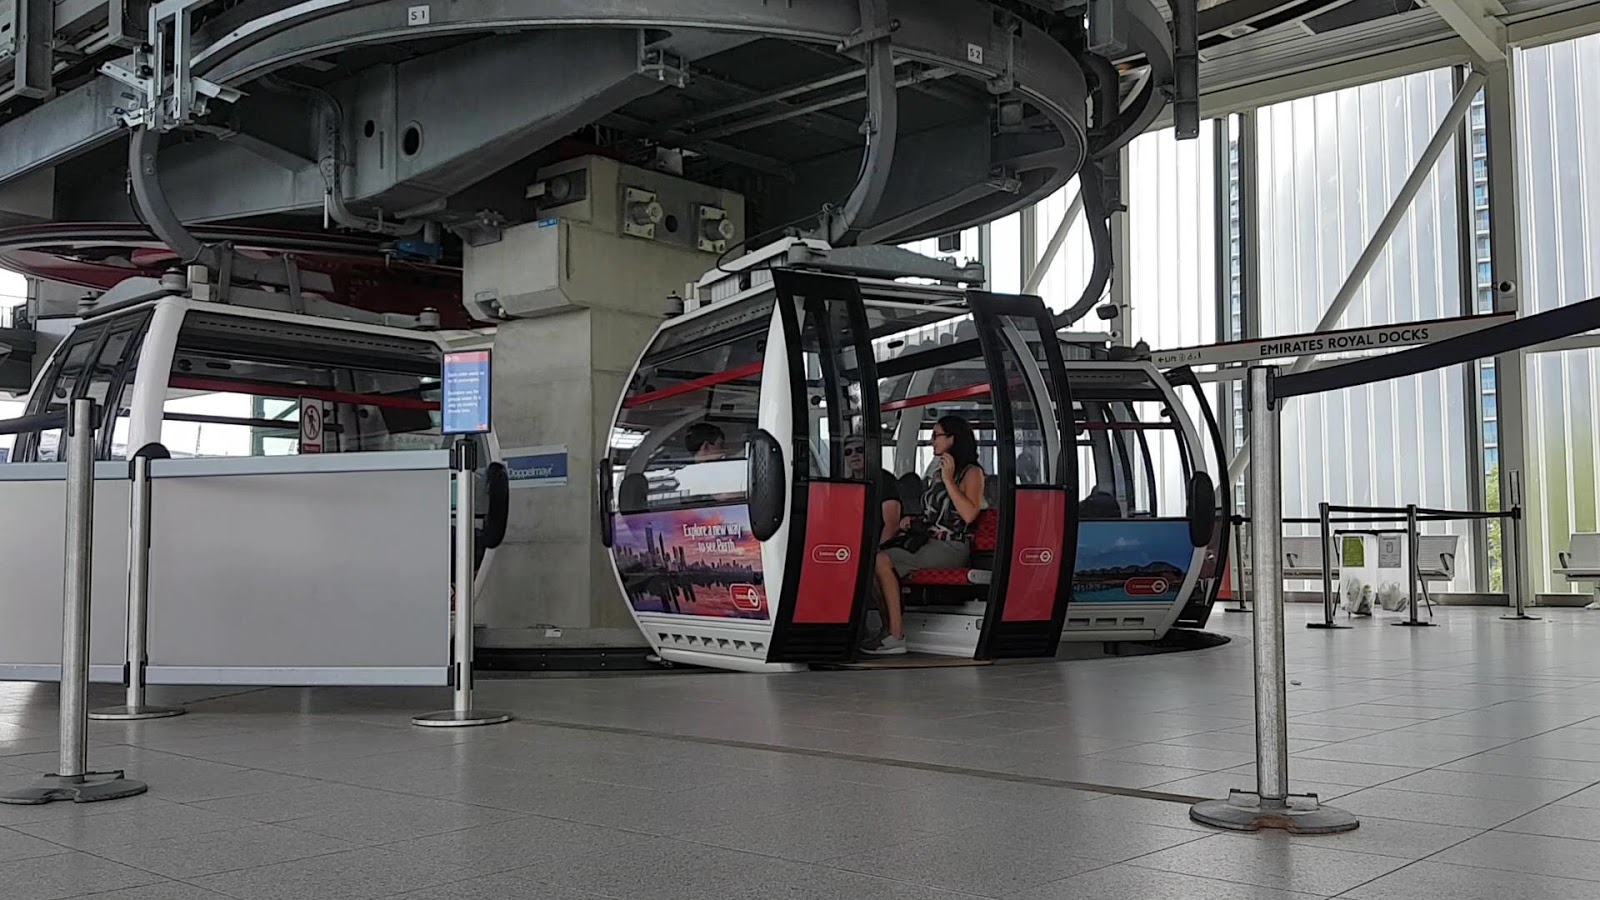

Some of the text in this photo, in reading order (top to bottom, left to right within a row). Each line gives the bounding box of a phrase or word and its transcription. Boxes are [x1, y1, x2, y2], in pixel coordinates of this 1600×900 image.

[1260, 328, 1429, 356] EMIRATES ROYAL DOCKS
[682, 522, 707, 540] Explore
[712, 524, 726, 536] new
[726, 523, 741, 539] way
